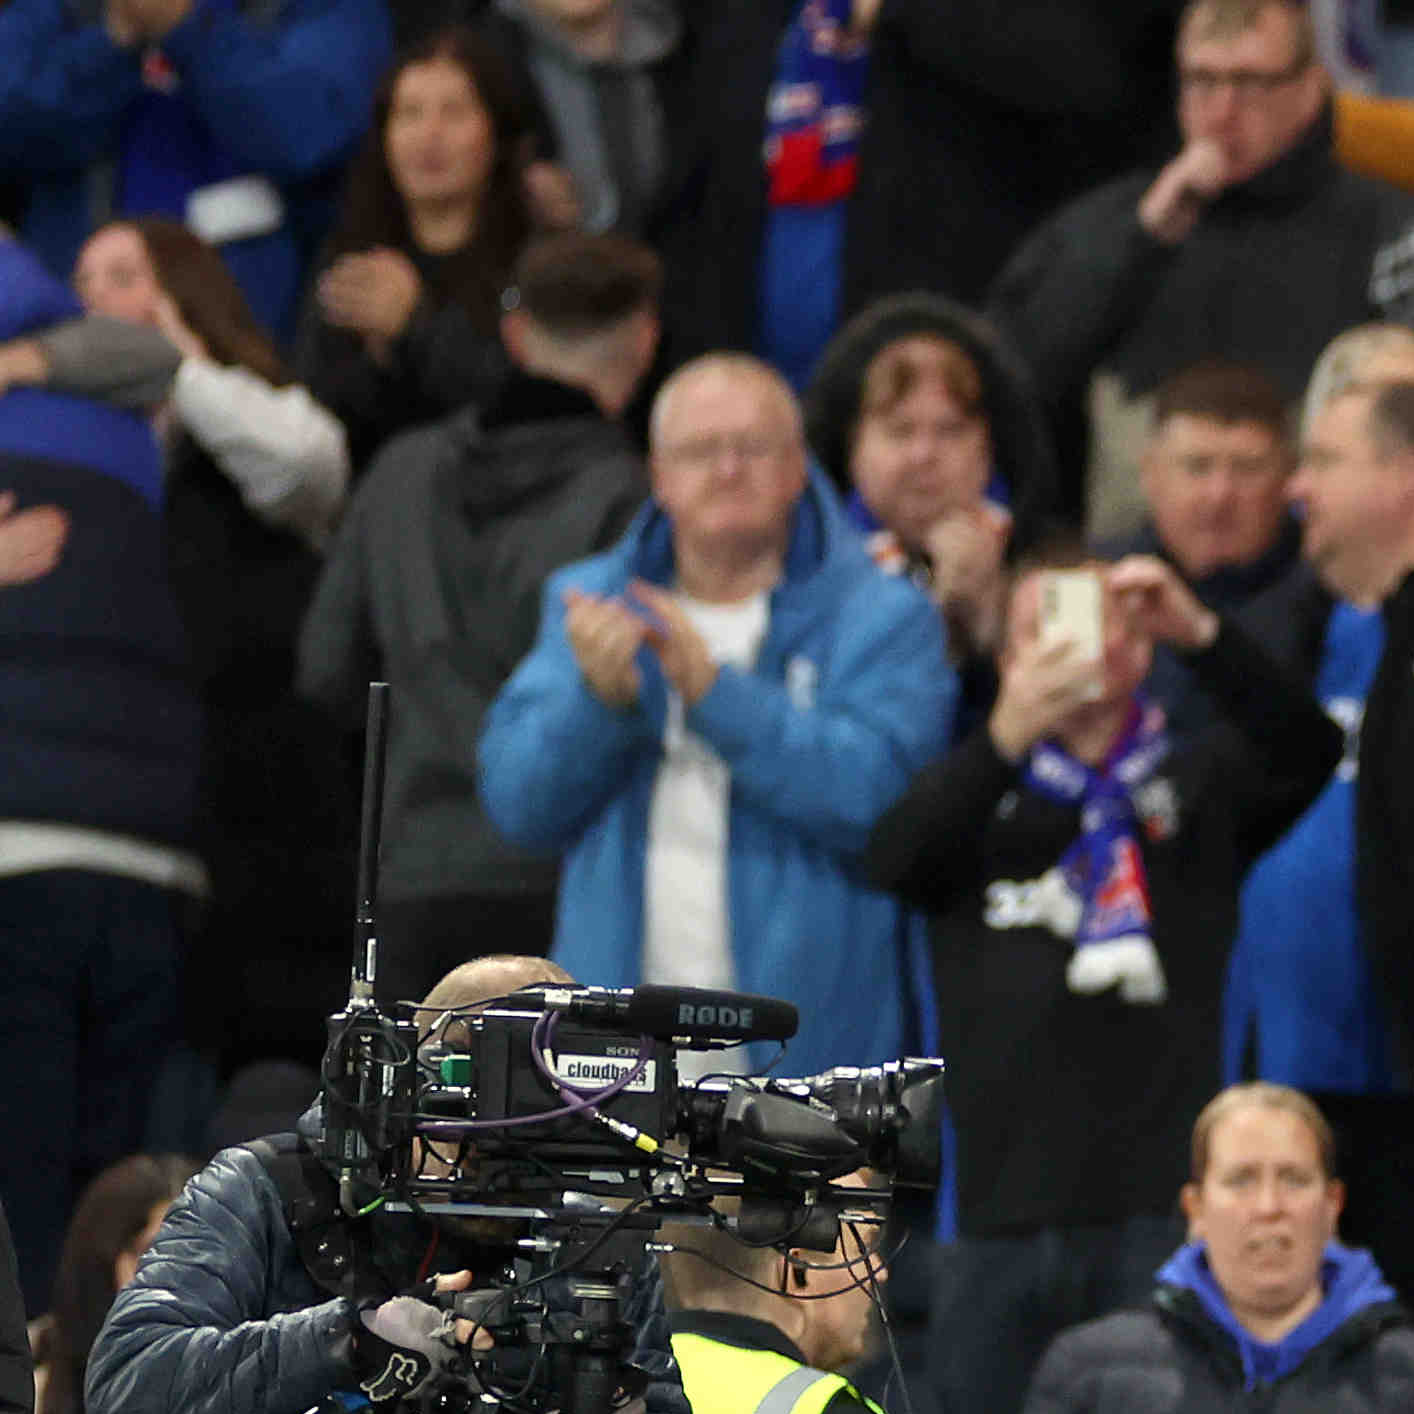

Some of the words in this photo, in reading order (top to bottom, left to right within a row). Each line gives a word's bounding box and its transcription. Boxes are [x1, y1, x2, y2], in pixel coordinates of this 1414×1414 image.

[678, 1003, 754, 1028] RØDE
[605, 1047, 641, 1057] SON
[567, 1061, 648, 1082] cloudbas
